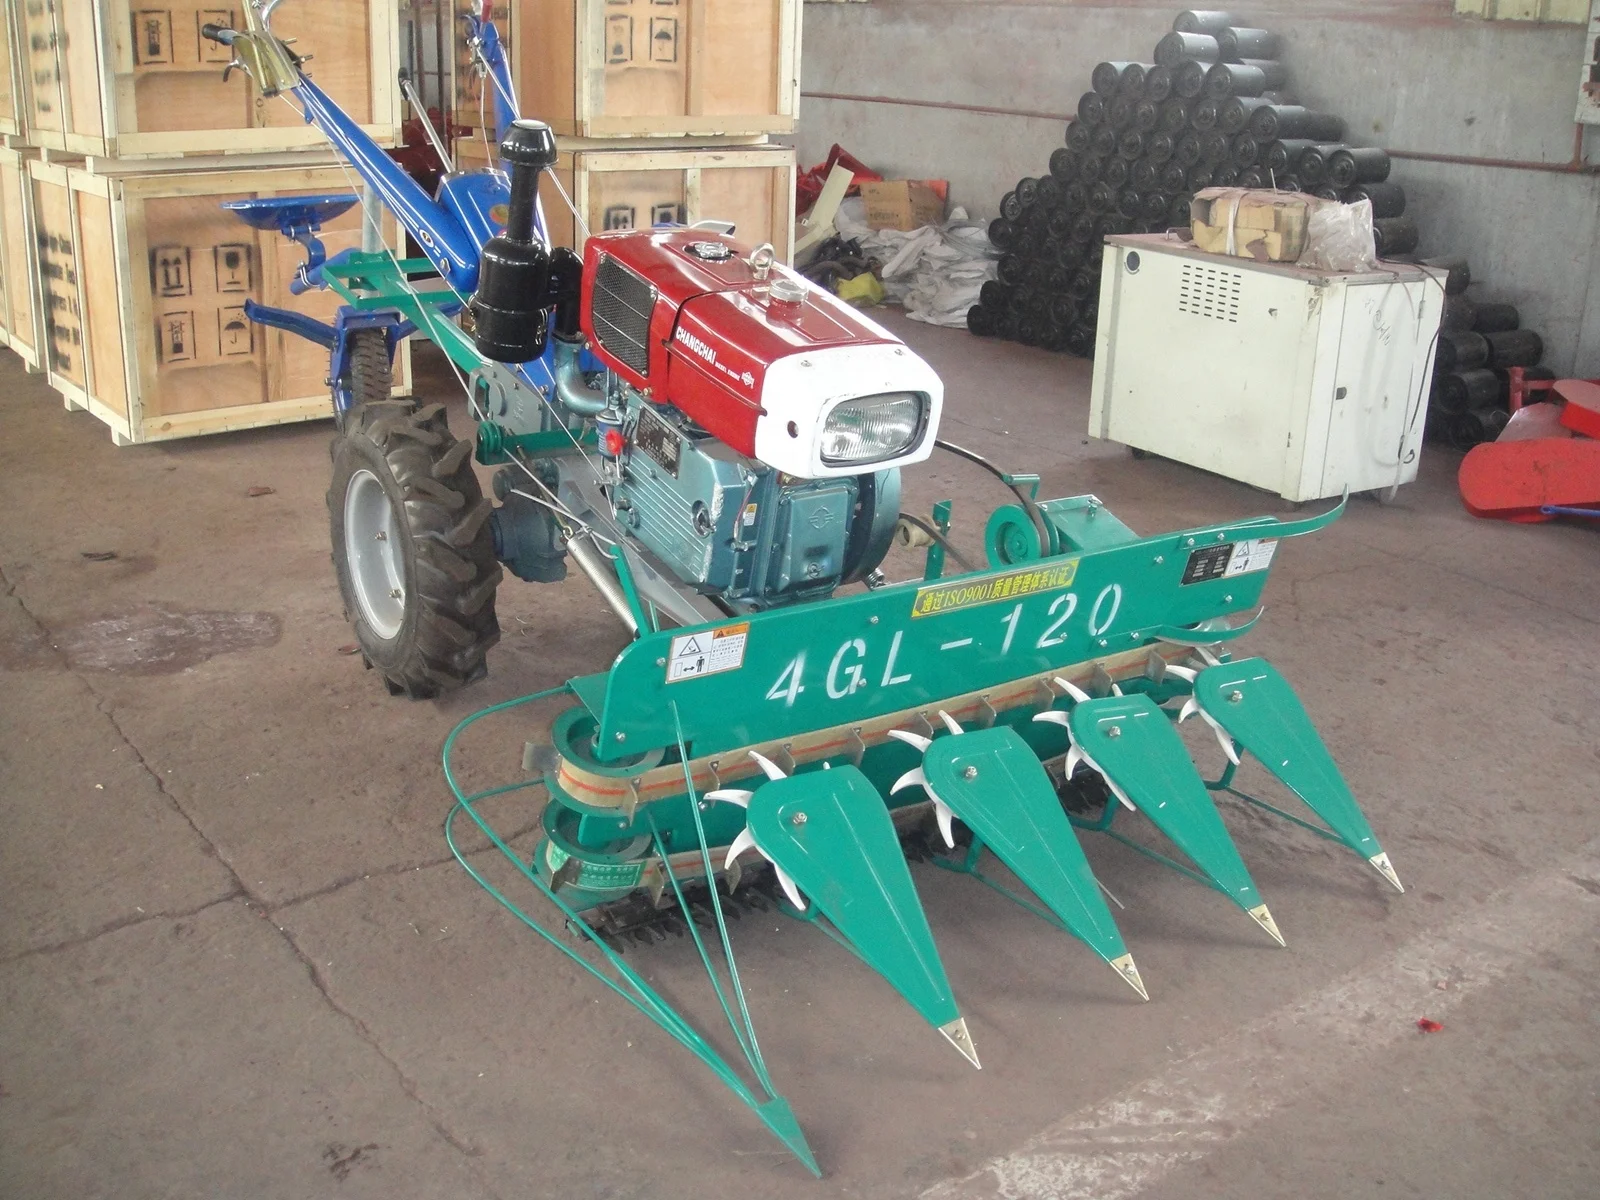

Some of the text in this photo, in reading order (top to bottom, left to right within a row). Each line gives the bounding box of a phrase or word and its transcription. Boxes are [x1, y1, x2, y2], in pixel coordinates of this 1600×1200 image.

[675, 326, 717, 365] CHANGCHAI
[920, 567, 1070, 613] 通过ISO9001质量管理体系认证
